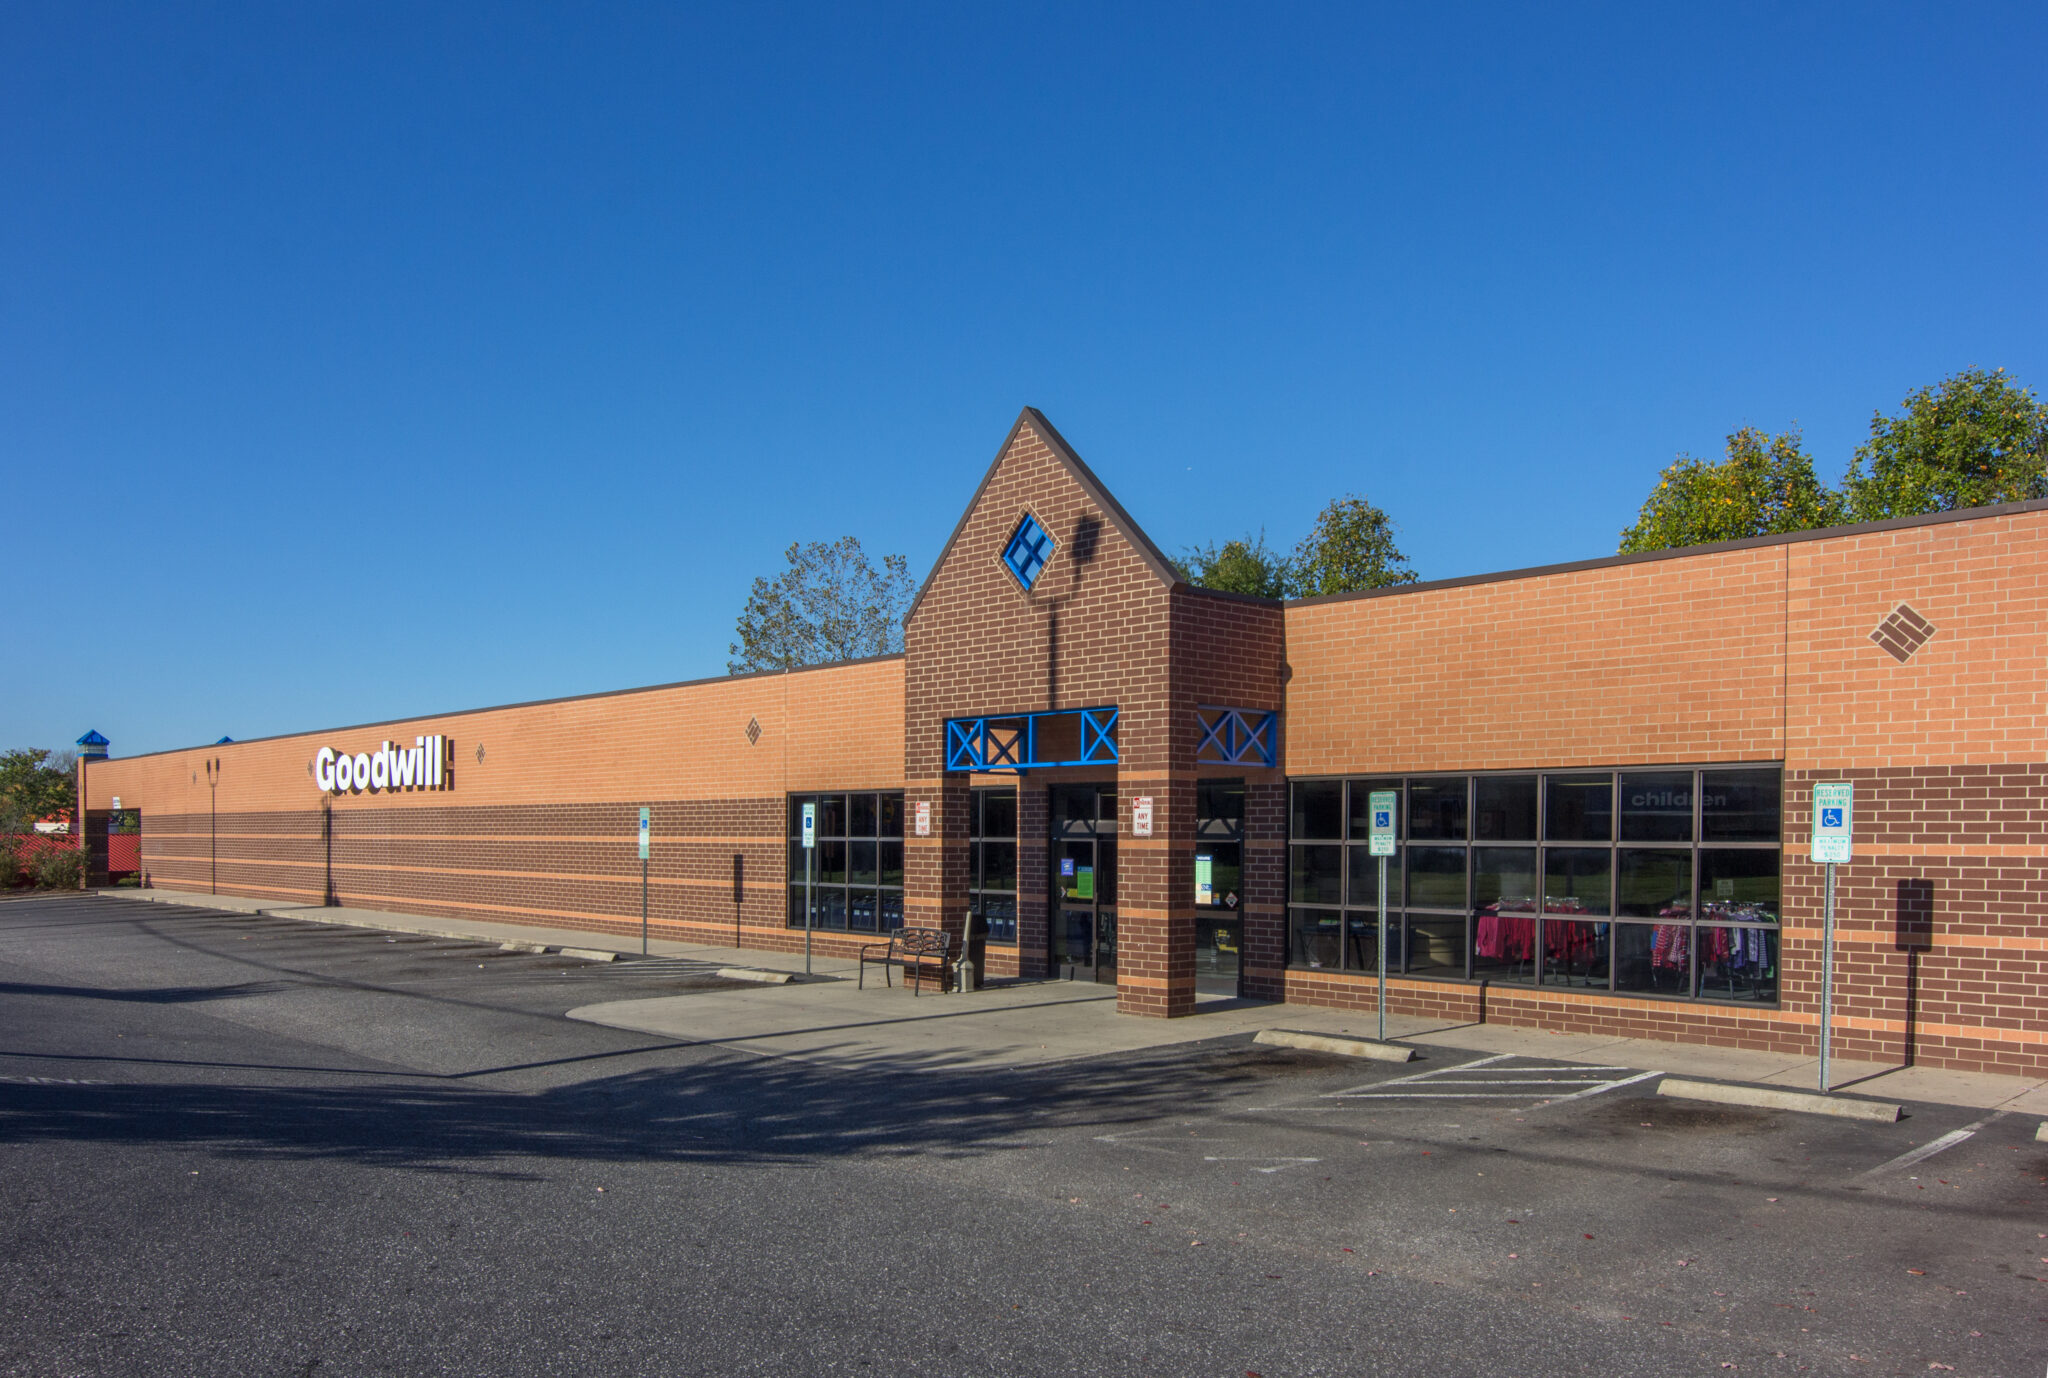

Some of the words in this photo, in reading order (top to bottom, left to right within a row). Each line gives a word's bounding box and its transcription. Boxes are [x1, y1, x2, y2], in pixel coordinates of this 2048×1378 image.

[316, 735, 442, 791] Goodwill
[1816, 789, 1850, 797] RESERVED
[1818, 798, 1847, 807] PARKING
[1136, 822, 1149, 830] TIME
